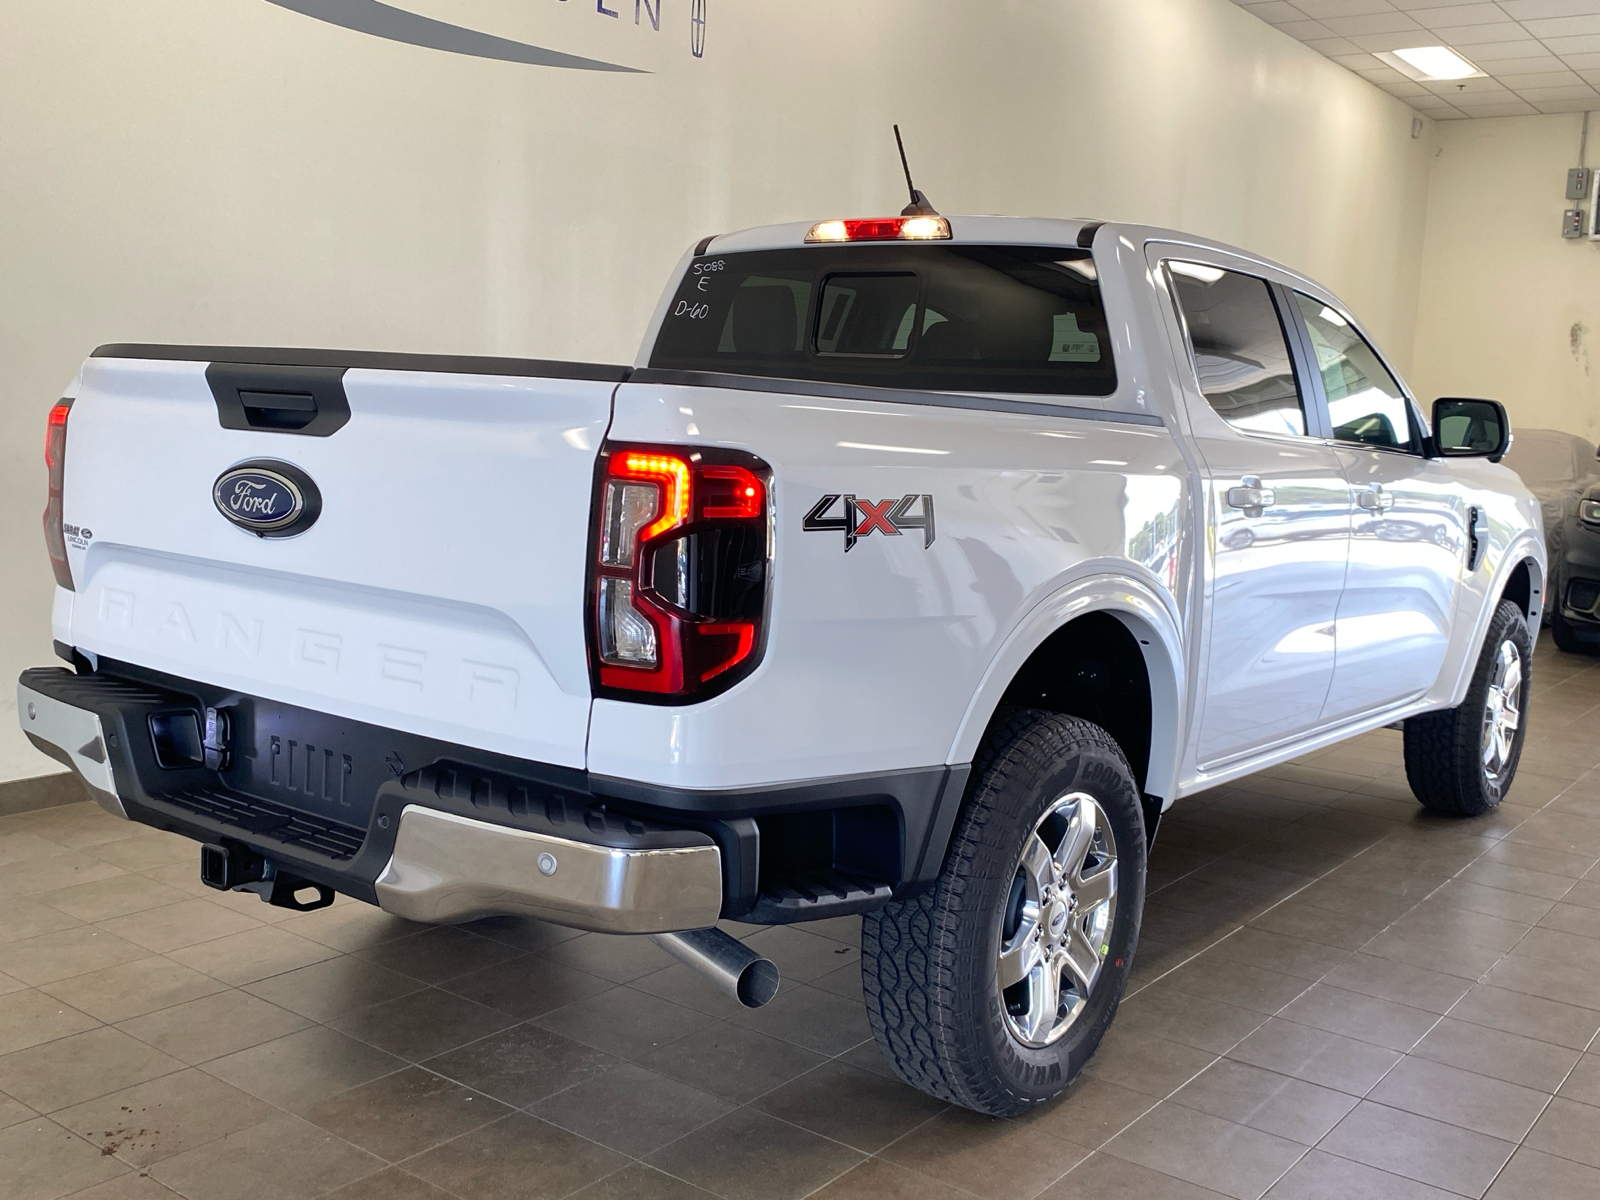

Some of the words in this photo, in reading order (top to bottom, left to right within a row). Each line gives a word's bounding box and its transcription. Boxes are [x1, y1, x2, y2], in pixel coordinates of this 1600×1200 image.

[697, 276, 711, 292] E
[230, 479, 278, 515] Ford
[97, 585, 521, 711] RANGER
